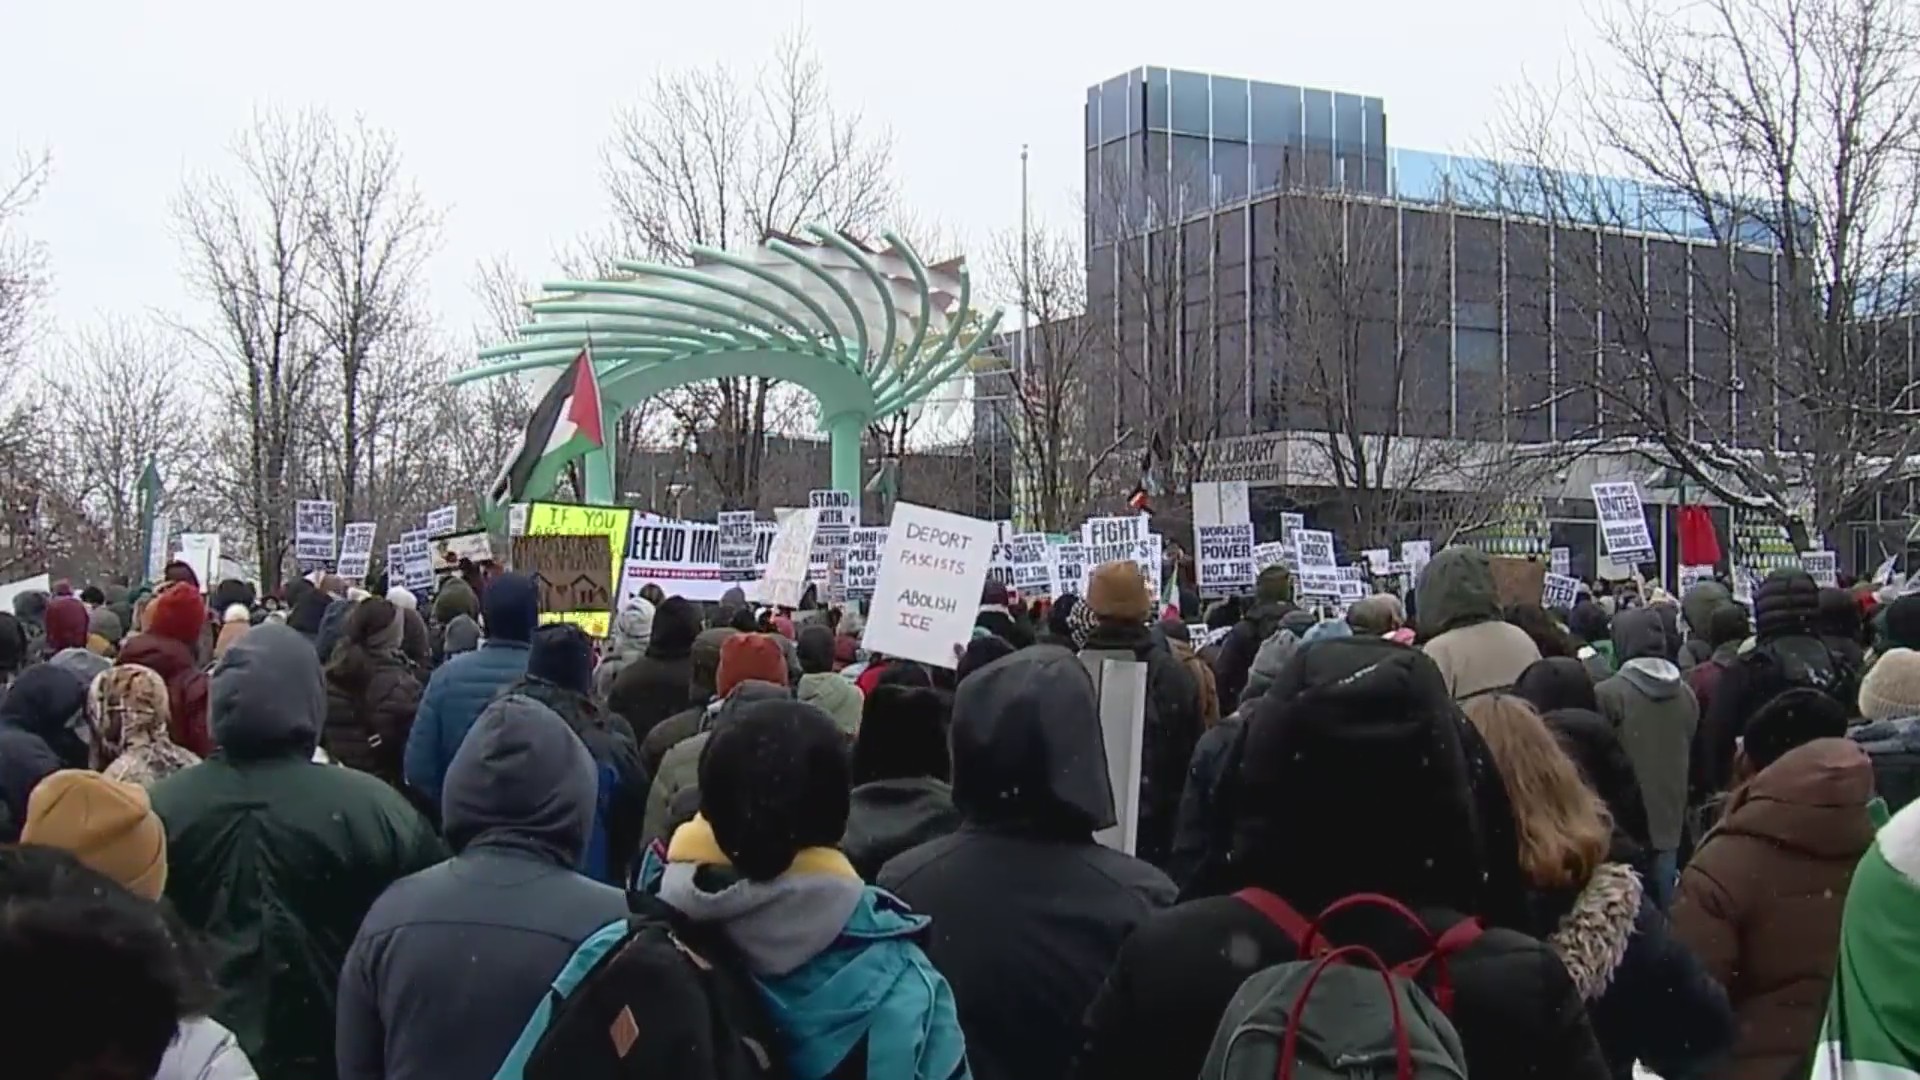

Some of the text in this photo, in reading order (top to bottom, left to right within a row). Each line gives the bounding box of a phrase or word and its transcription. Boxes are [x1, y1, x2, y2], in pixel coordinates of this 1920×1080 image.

[812, 493, 849, 507] STAND
[1598, 495, 1638, 511] UNITED
[550, 507, 616, 528] IF YOU
[906, 522, 972, 550] DEPORT
[1091, 519, 1140, 544] FIGHT
[1200, 525, 1251, 536] WORKERS
[631, 525, 686, 562] EFEND
[1086, 540, 1148, 565] TRUMP'S
[1201, 544, 1251, 559] POWER
[900, 550, 966, 575] FASCISTS
[1059, 564, 1081, 579] END
[1202, 563, 1251, 575] NOT THE
[898, 589, 957, 613] ABOLISH
[898, 612, 933, 631] ICE
